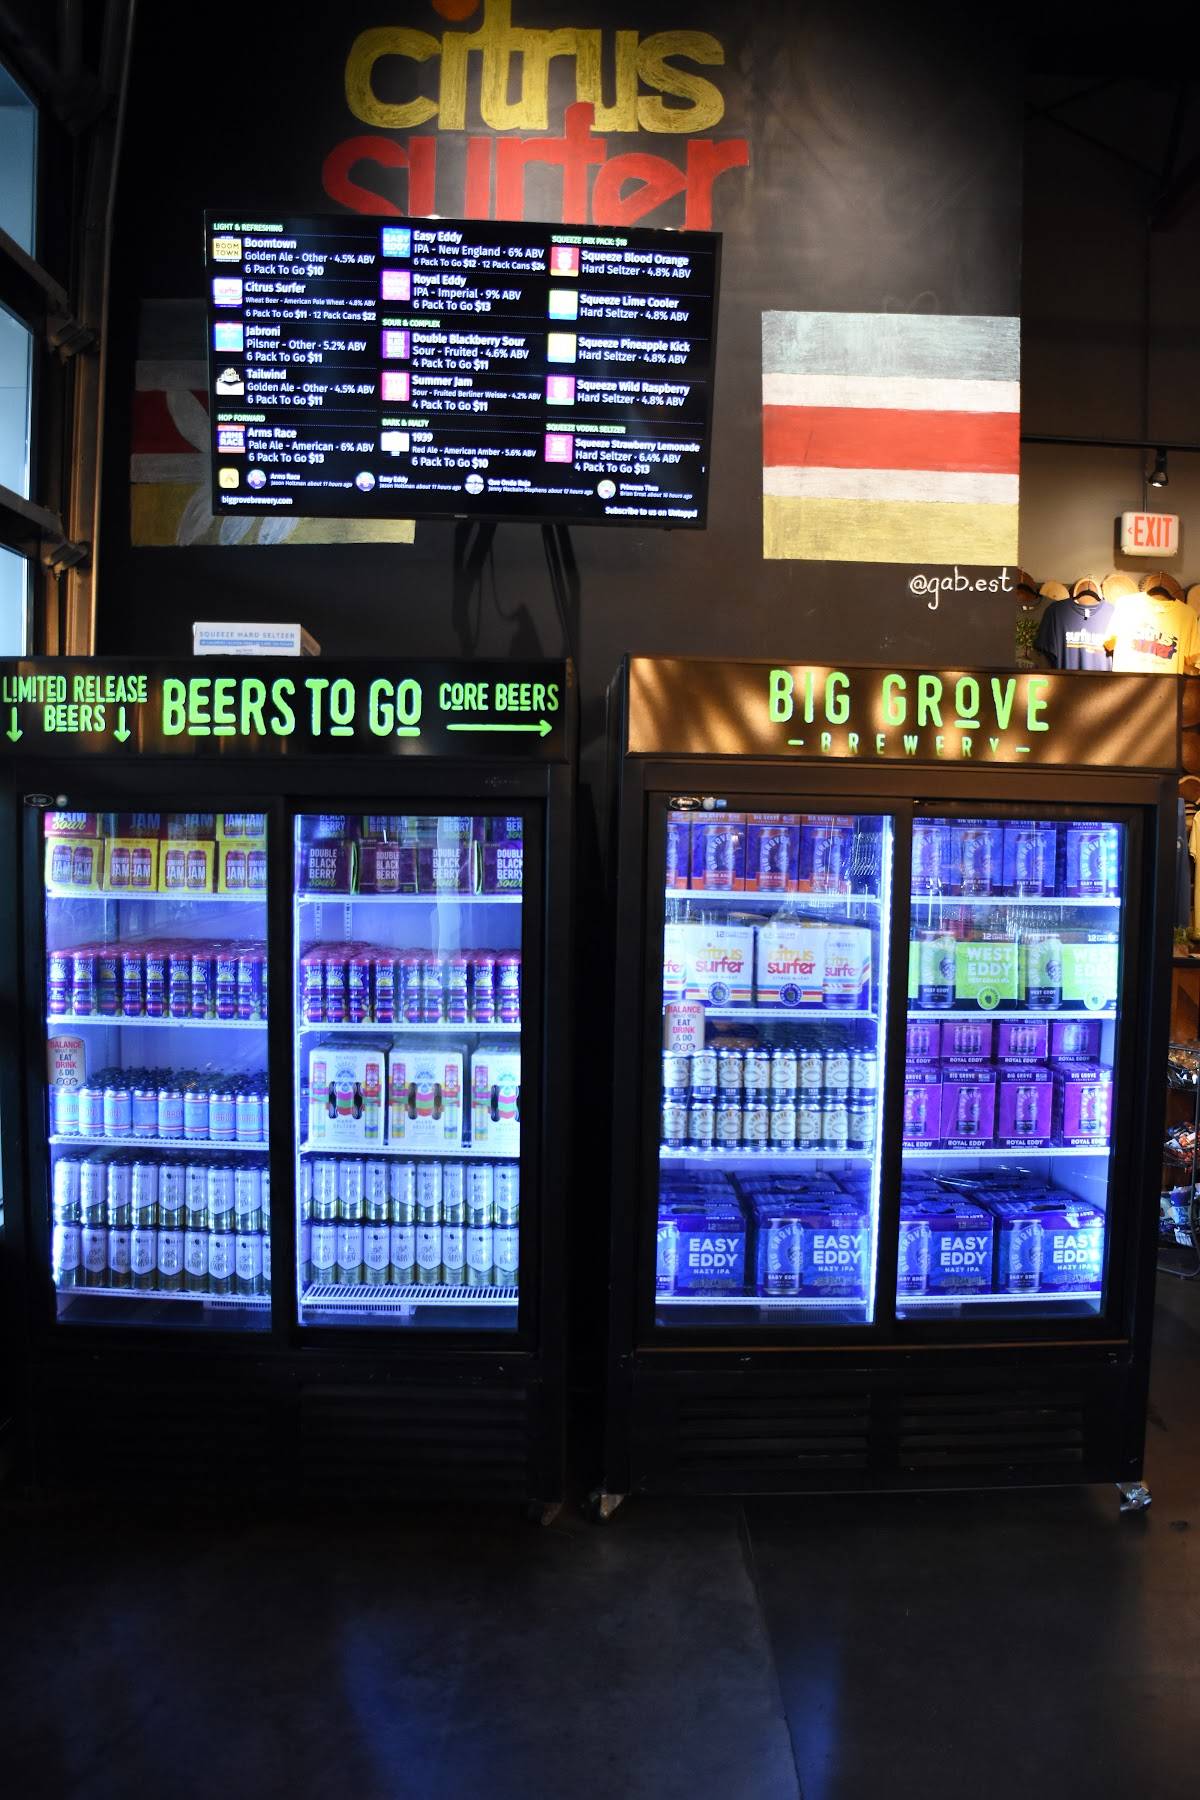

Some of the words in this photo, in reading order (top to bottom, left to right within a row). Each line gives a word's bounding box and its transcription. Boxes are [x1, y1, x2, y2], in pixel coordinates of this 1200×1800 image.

[345, 0, 724, 133] citrus
[213, 223, 233, 231] LIGHT
[242, 224, 283, 232] REFRESHING
[244, 238, 296, 250] Boomtown
[414, 231, 436, 243] Easy
[438, 232, 462, 244] Eddy
[414, 244, 429, 254] IPA
[439, 245, 460, 255] New
[462, 246, 500, 257] England
[508, 248, 522, 258] 6%
[525, 248, 544, 258] ABV
[245, 252, 278, 262] Golden
[280, 253, 293, 262] Ale
[302, 254, 327, 263] Other
[335, 255, 355, 264] 4.5%
[357, 256, 375, 264] ABV
[582, 251, 622, 263] Squeeze
[624, 253, 652, 263] Blood
[654, 254, 689, 268] Orange
[245, 265, 251, 274] 6
[254, 265, 275, 274] Pack
[278, 266, 289, 274] To
[291, 267, 305, 275] Go
[307, 265, 324, 277] $10
[582, 264, 604, 274] Hard
[607, 265, 640, 275] Seltzer
[647, 268, 670, 277] 4.8%
[672, 268, 691, 278] ABV
[413, 274, 440, 286] Royal
[442, 275, 467, 286] Eddy
[245, 282, 273, 292] Citrus
[275, 283, 305, 293] Surfer
[414, 287, 428, 297] IPA
[438, 288, 478, 299] Imperial
[486, 290, 500, 299] 9%
[502, 290, 522, 300] ABV
[580, 294, 620, 306] Squeeze
[622, 296, 645, 307] Lime
[648, 297, 679, 308] Cooler
[580, 307, 602, 317] Hard
[605, 308, 638, 319] Seltzer
[645, 311, 668, 320] 4.8%
[670, 312, 689, 322] ABV
[246, 326, 281, 337] Jabroni
[246, 340, 279, 350] Pilsner
[289, 341, 316, 350] Other
[324, 341, 346, 351] 5.2%
[348, 342, 366, 351] ABV
[413, 333, 447, 344] Double
[449, 334, 501, 347] Blackberry
[502, 336, 525, 346] Sour
[578, 337, 619, 349] Squeeze
[621, 338, 668, 351] Pineapple
[670, 341, 690, 352] Kick
[413, 346, 435, 356] Sour
[444, 347, 478, 357] Fruited
[485, 349, 508, 358] 4.6%
[510, 349, 529, 359] ABV
[246, 369, 287, 380] Tailwind
[412, 376, 452, 385] Summer
[454, 376, 472, 387] Jam
[577, 380, 617, 392] Squeeze
[619, 381, 640, 391] Wild
[642, 382, 690, 396] Raspberry
[248, 383, 278, 392] Golden
[280, 383, 294, 392] Ale
[303, 384, 327, 393] Other
[335, 385, 355, 394] 4.5%
[357, 386, 375, 394] ABV
[248, 428, 272, 438] Arms
[273, 429, 297, 439] Race
[412, 433, 433, 442] 1939
[249, 441, 269, 450] Pale
[270, 442, 283, 450] Ale
[292, 442, 334, 451] American
[341, 443, 355, 451] 6%
[357, 444, 374, 452] ABV
[575, 439, 610, 449] Squeeze
[612, 440, 656, 452] Strawberry
[658, 442, 700, 452] Lemonade
[575, 451, 598, 460] Hard
[600, 452, 632, 462] Seltzer
[639, 454, 660, 463] 6.4%
[662, 454, 681, 463] ABV
[575, 464, 581, 472] 4
[583, 464, 604, 473] Pack
[606, 464, 617, 473] To
[620, 465, 632, 474] Go
[634, 464, 650, 475] $13
[222, 496, 293, 505] biggrovebrewery.com
[1134, 516, 1172, 547] EXIT
[910, 566, 1013, 610] @gab.est
[3, 676, 67, 703] LIMITED
[74, 676, 147, 703] RELEASE
[440, 683, 489, 711] CORE
[495, 683, 559, 711] BEERS
[769, 670, 850, 726] BIG
[882, 674, 1050, 731] GROVE
[162, 678, 296, 736] BEERS
[305, 678, 355, 736] TO
[369, 678, 422, 736] GO
[44, 704, 106, 733] BEERS
[821, 732, 999, 758] BREWERY
[310, 849, 337, 857] DOUBLE
[433, 849, 460, 857] DOUBLE
[112, 863, 130, 877] JAM
[309, 859, 336, 868] BLACK
[433, 859, 460, 868] BLACK
[133, 864, 151, 878] JAM
[167, 865, 184, 879] JAM
[188, 866, 205, 880] JAM
[309, 870, 336, 879] BERRY
[433, 869, 460, 880] BERRY
[967, 947, 1012, 960] WEST
[695, 957, 744, 974] surfer
[768, 957, 816, 974] surfer
[968, 963, 1012, 976] EDDY
[667, 1005, 700, 1014] BALANCE
[49, 1040, 82, 1048] BALANCE
[689, 1238, 740, 1252] EASY
[814, 1235, 863, 1248] EASY
[941, 1237, 988, 1250] EASY
[689, 1254, 738, 1267] EDDY
[813, 1251, 862, 1264] EDDY
[940, 1252, 987, 1265] EDDY
